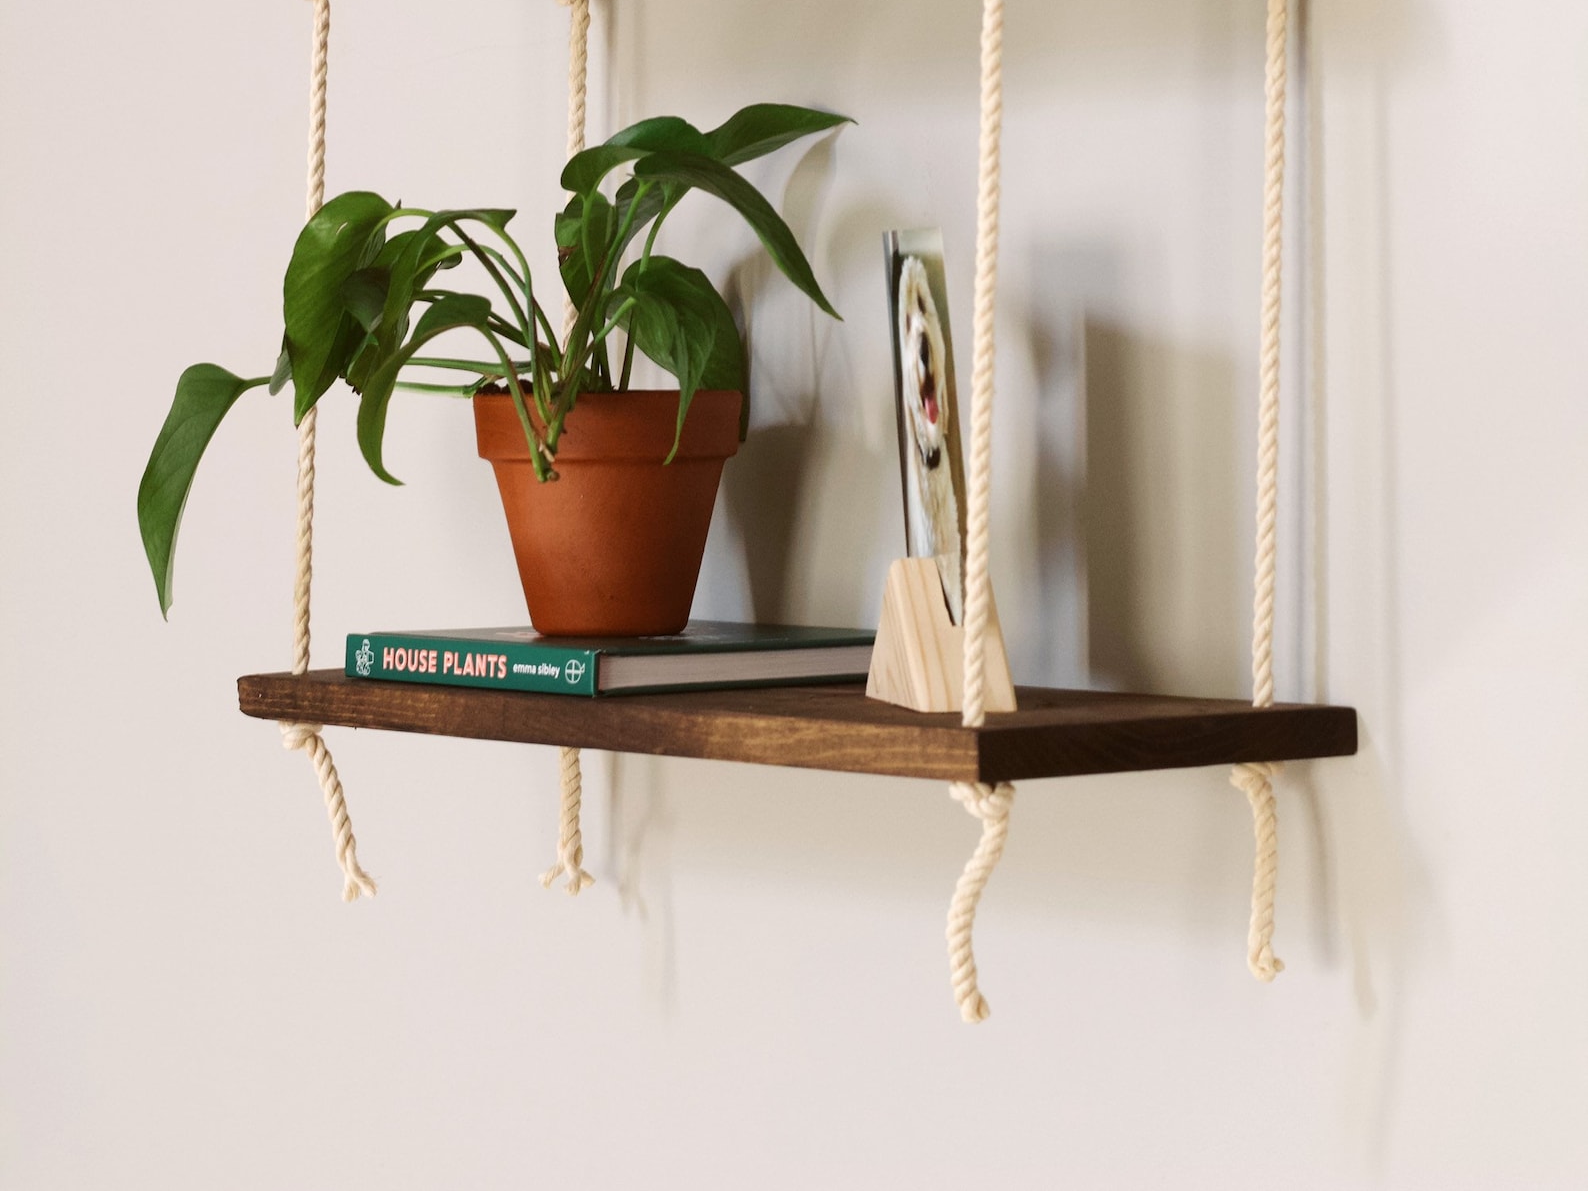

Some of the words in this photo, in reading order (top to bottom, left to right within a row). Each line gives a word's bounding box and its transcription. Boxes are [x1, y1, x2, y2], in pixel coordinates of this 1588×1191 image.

[383, 647, 438, 673] HOUSE
[443, 651, 507, 679] PLANTS
[513, 663, 536, 675] emma
[538, 662, 560, 679] sibley
